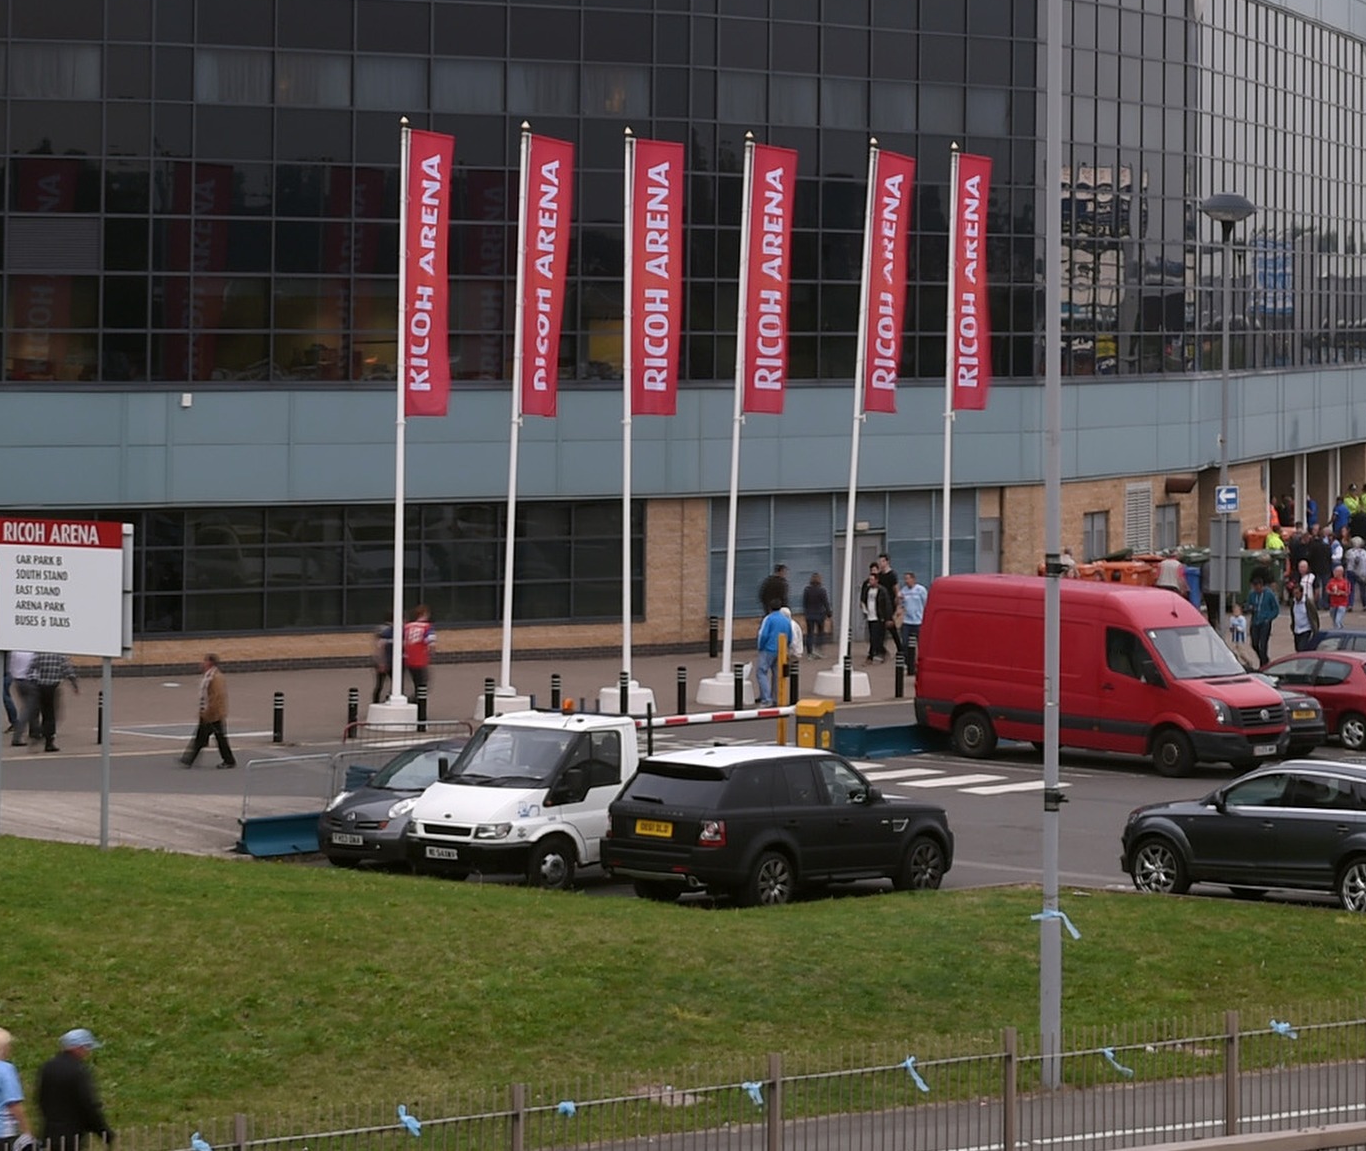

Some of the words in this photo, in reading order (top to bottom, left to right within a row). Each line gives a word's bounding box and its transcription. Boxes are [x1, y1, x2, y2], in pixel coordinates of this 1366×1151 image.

[418, 154, 442, 276] ARENA
[535, 160, 560, 279] ARENA
[645, 162, 670, 280] ARENA
[761, 167, 784, 282] ARENA
[882, 174, 904, 284] ARENA
[964, 175, 981, 284] ARENA
[409, 286, 434, 391] RICOH
[643, 288, 670, 391] RICOH
[753, 290, 783, 391] RICOH
[871, 292, 897, 391] RICOH
[957, 292, 979, 388] RICOH
[2, 521, 46, 543] RICOH
[49, 523, 100, 546] ARENA
[15, 568, 42, 580] SOUTH
[43, 569, 68, 581] STAND
[16, 554, 32, 565] CAR
[33, 555, 55, 566] PARK
[15, 584, 33, 595] EAST
[35, 585, 61, 597] STAND
[15, 600, 42, 611] ARENA
[43, 601, 65, 612] PARK
[15, 615, 39, 627] BUSES
[40, 616, 46, 627] &
[48, 616, 71, 628] TAXIS
